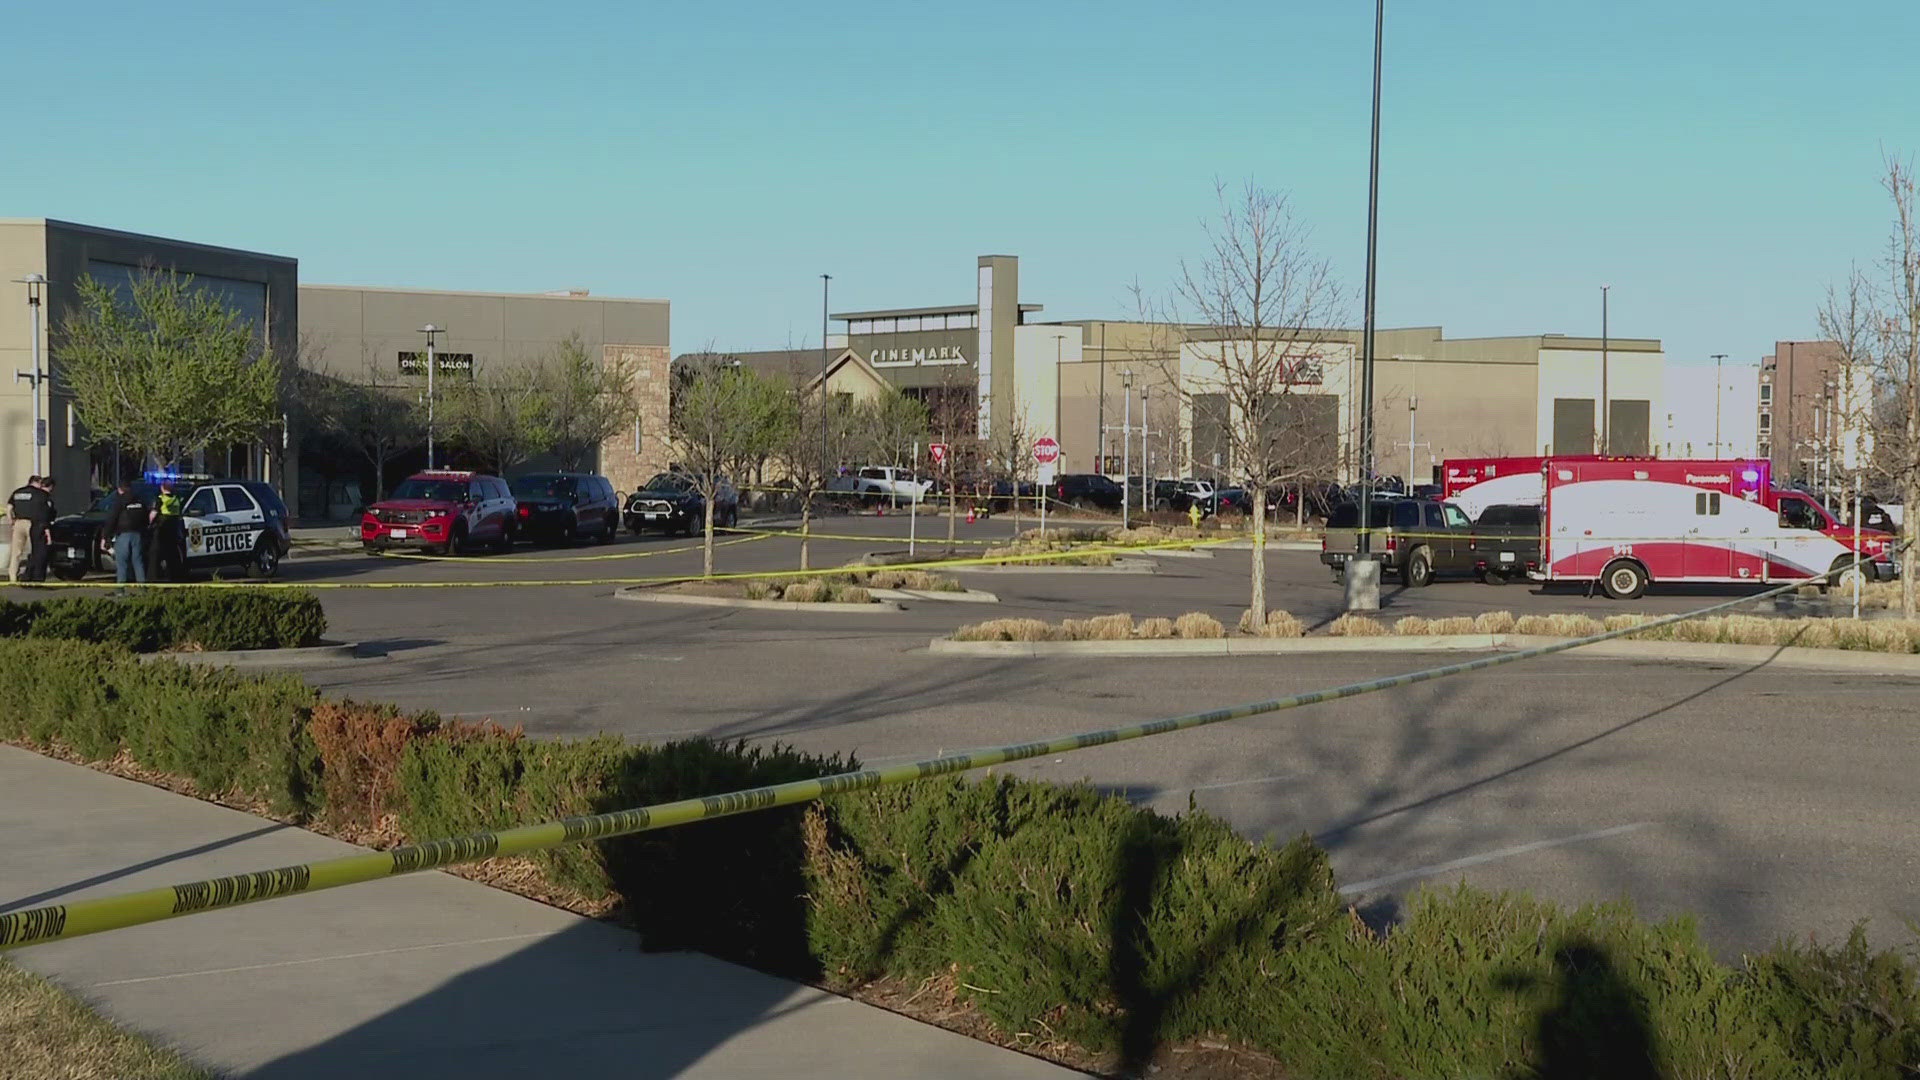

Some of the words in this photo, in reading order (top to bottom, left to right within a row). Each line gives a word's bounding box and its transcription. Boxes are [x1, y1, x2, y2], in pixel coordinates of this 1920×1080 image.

[870, 344, 967, 368] CINEMARK
[439, 361, 469, 369] SALON
[1035, 444, 1058, 457] STOP
[1685, 473, 1731, 484] Paramedic
[225, 524, 251, 532] COLLINS
[205, 533, 252, 553] POLICE
[1613, 543, 1633, 556] 911
[275, 863, 310, 894] POLICE
[18, 904, 67, 942] POLICE
